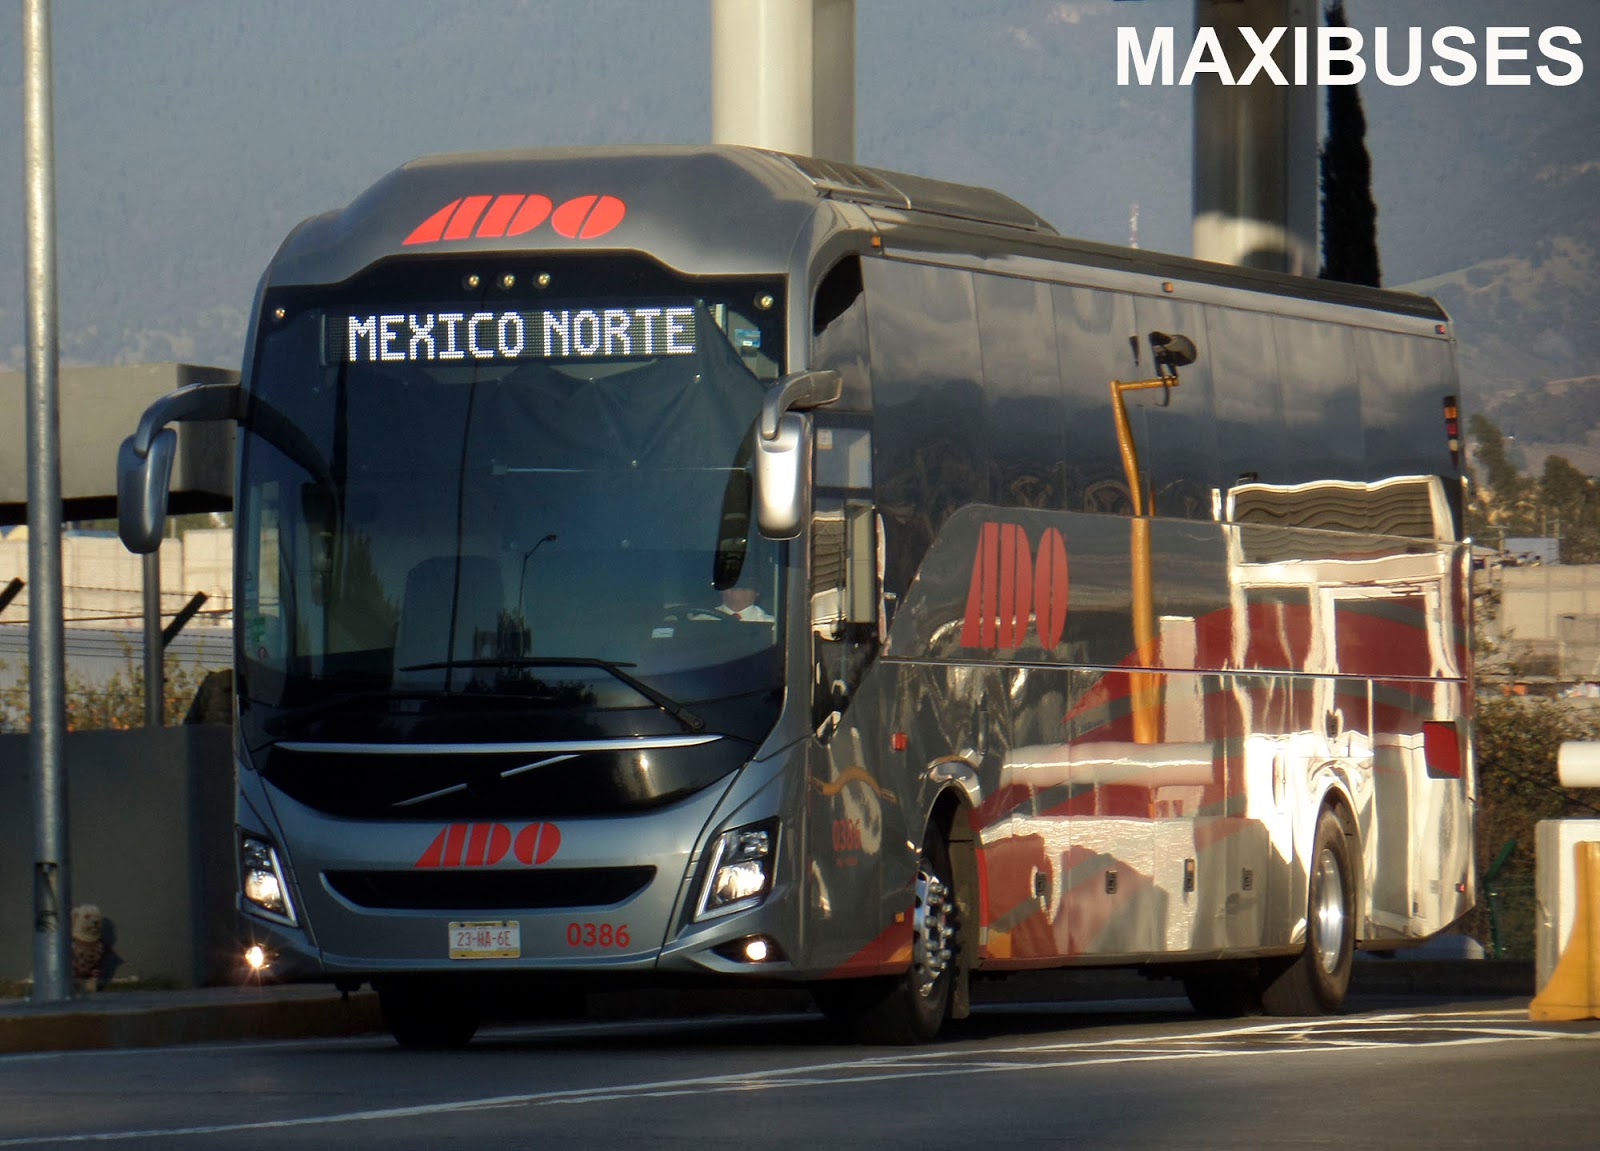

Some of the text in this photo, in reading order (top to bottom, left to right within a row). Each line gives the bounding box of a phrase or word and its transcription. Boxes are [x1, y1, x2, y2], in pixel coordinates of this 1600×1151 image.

[402, 193, 627, 246] ADO
[348, 307, 695, 362] MEXICO NORTE
[960, 521, 1069, 652] ADO
[413, 821, 562, 868] ADO
[566, 921, 631, 948] 0386
